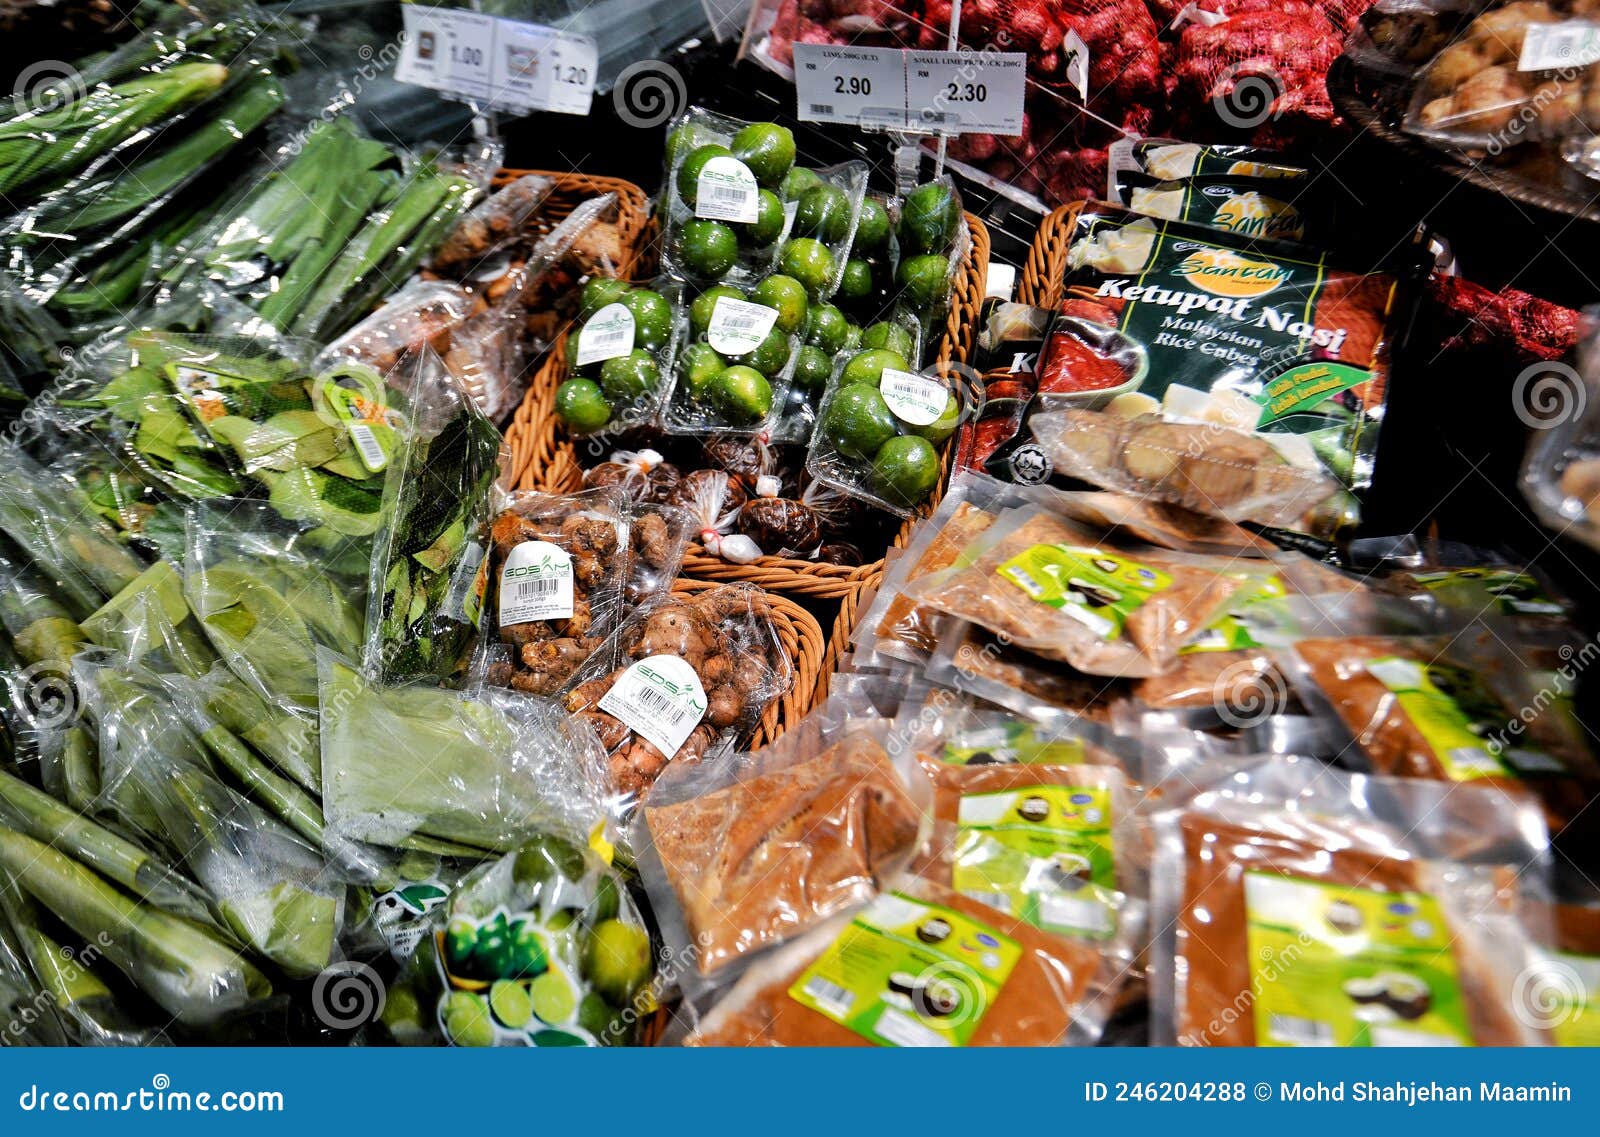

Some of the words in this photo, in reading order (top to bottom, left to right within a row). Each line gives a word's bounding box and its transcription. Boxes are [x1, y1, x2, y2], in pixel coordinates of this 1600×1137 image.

[451, 44, 483, 67] 1.00
[553, 63, 588, 86] 1.20
[834, 75, 871, 96] 2.90
[918, 70, 929, 78] RM
[947, 82, 987, 103] 2.30
[1169, 258, 1295, 281] Santan
[1094, 279, 1252, 321] Ketupat
[1254, 305, 1348, 353] Nasi
[1159, 316, 1264, 349] Malaysian
[1153, 332, 1197, 351] Rice
[1199, 342, 1261, 367] Cubes
[504, 557, 570, 578] EDSAM
[636, 663, 705, 716] EDSAM
